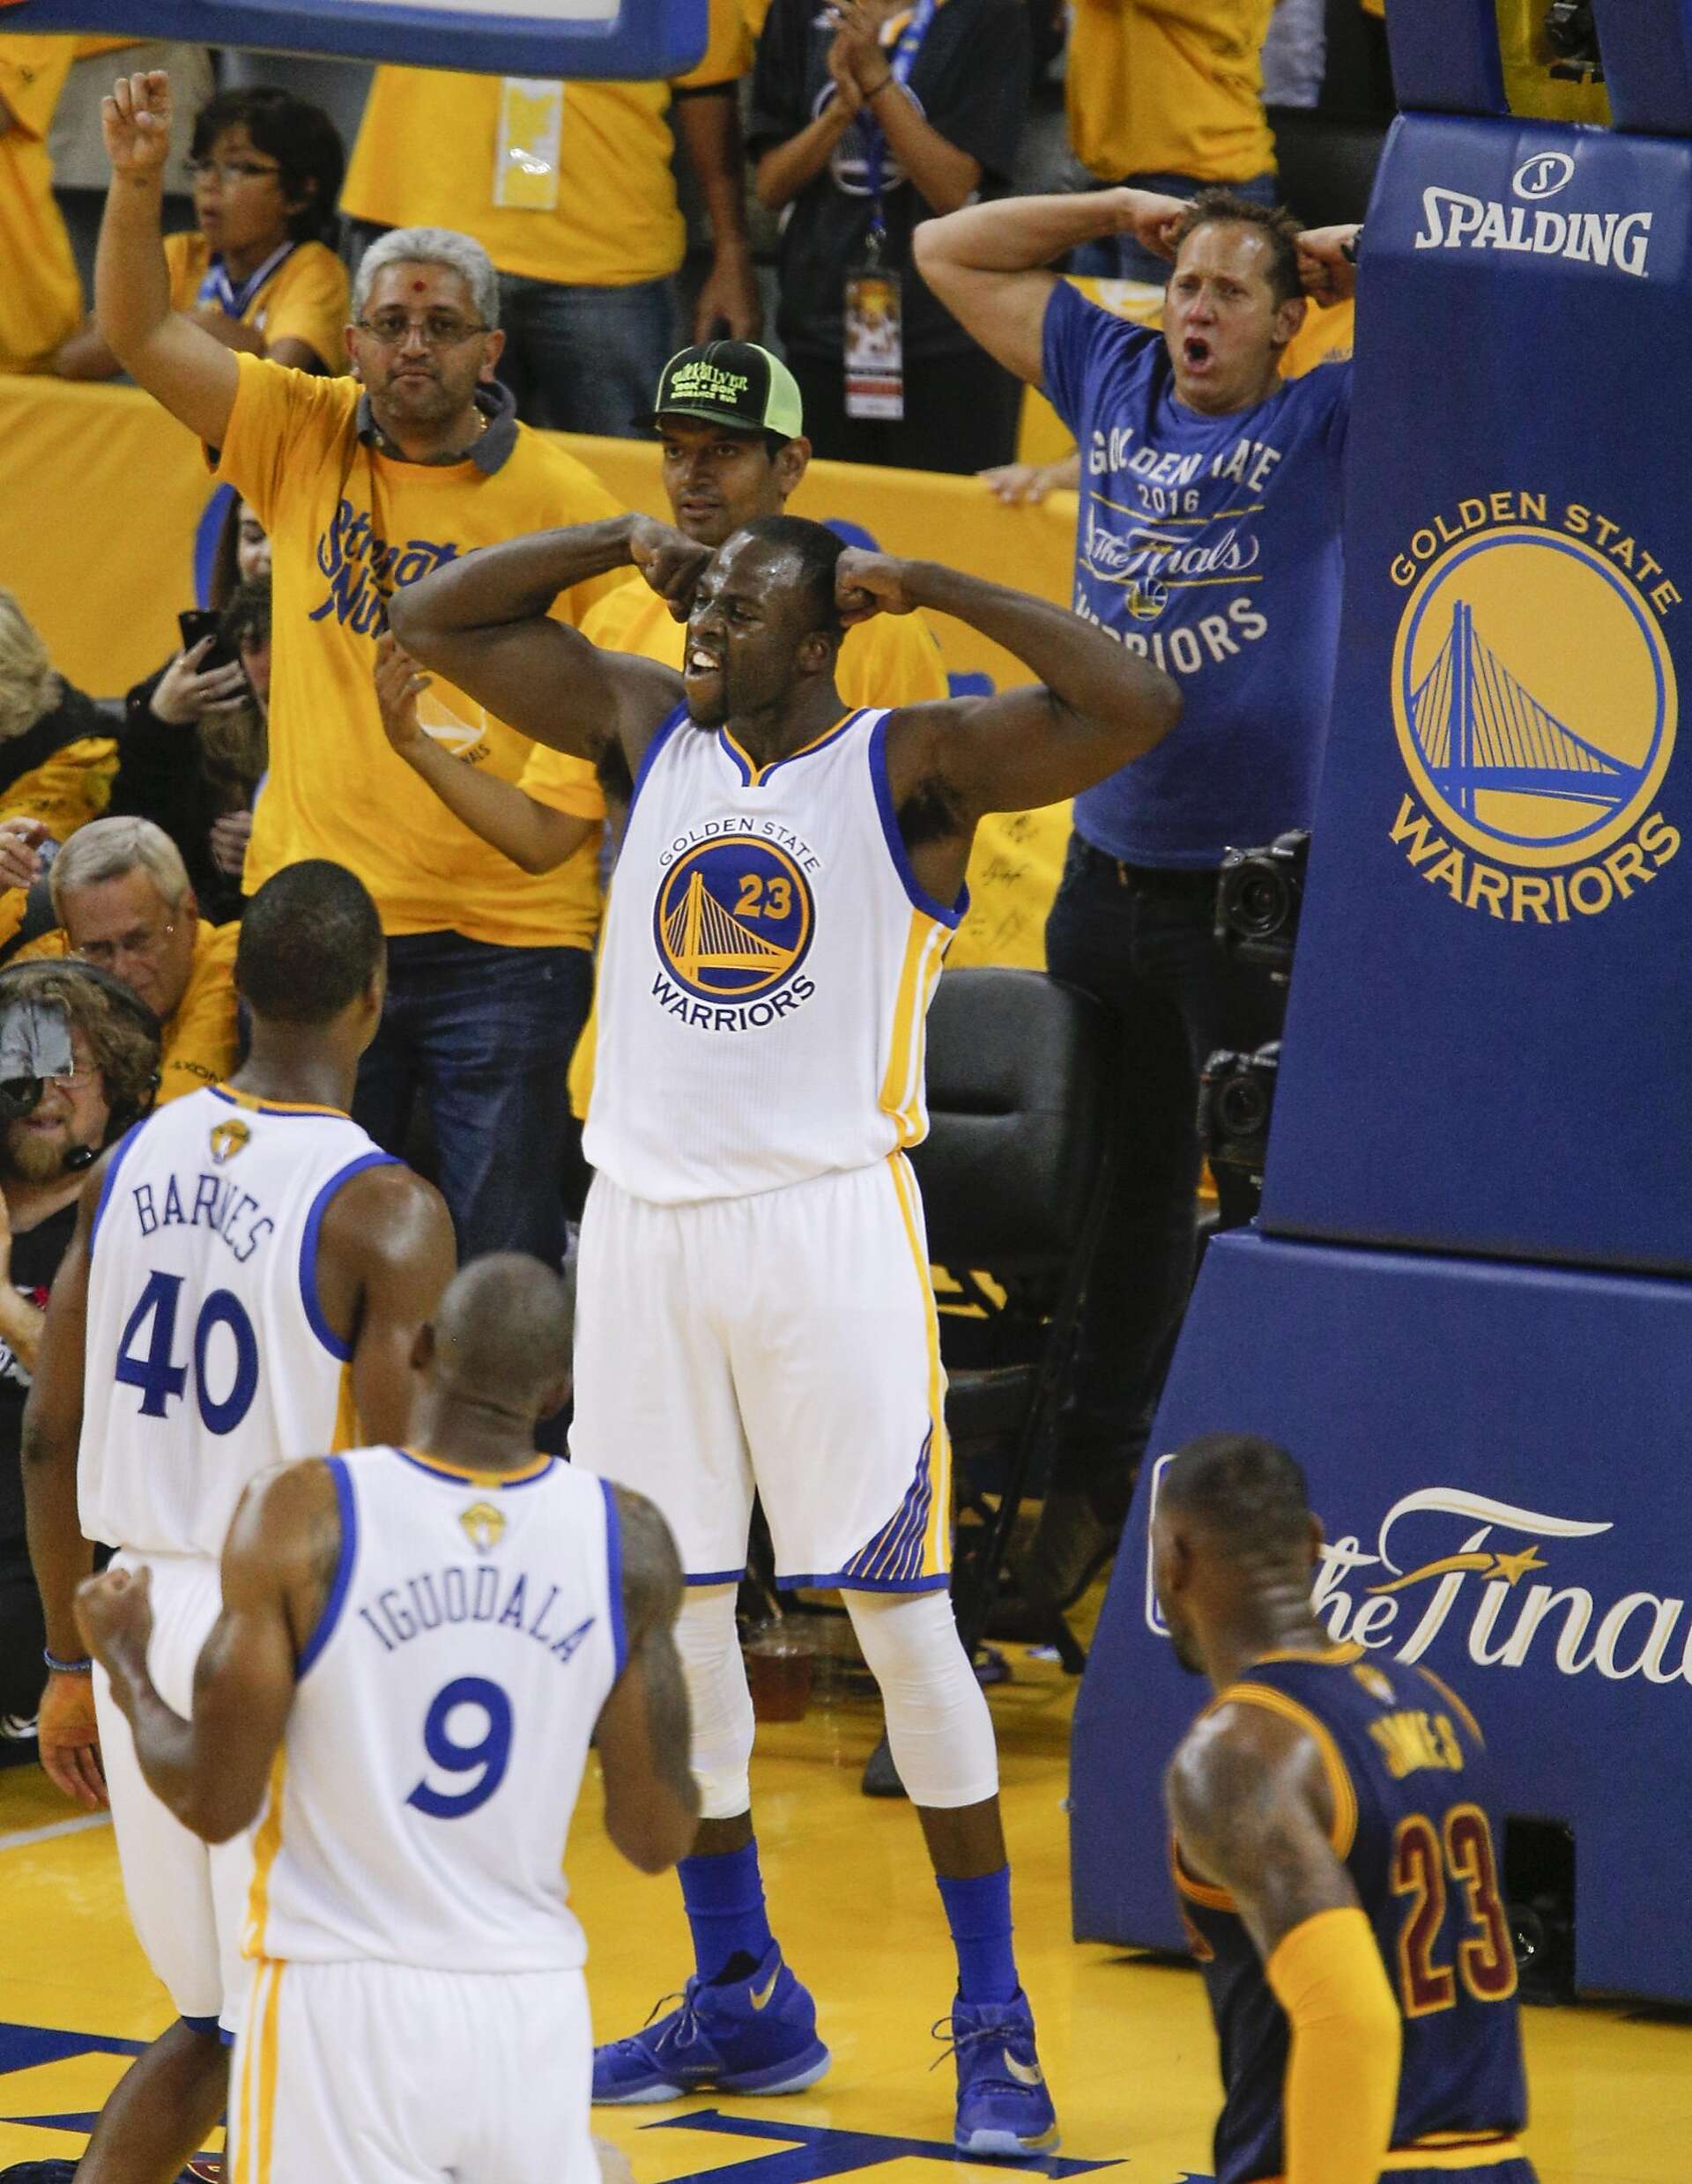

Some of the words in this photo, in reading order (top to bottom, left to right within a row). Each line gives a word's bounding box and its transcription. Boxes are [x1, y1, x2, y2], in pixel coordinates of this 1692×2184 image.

[1414, 186, 1653, 278] SPALDING
[1138, 483, 1200, 516] 2016
[1390, 490, 1548, 588] GOLDEN
[1563, 503, 1683, 615] STATE
[658, 818, 755, 867] GOLDEN
[761, 821, 821, 873] STATE
[1388, 793, 1682, 925] WARRIORS
[733, 873, 792, 920] 23
[650, 972, 816, 1032] WARRIORS
[132, 1173, 274, 1263] BARNES
[115, 1270, 259, 1435] 40
[360, 1565, 597, 1663] IGUODALA
[1310, 1535, 1399, 1648] he
[1378, 1486, 1692, 1685] Fina
[404, 1676, 515, 1820] 9
[1389, 1803, 1518, 2018] 23
